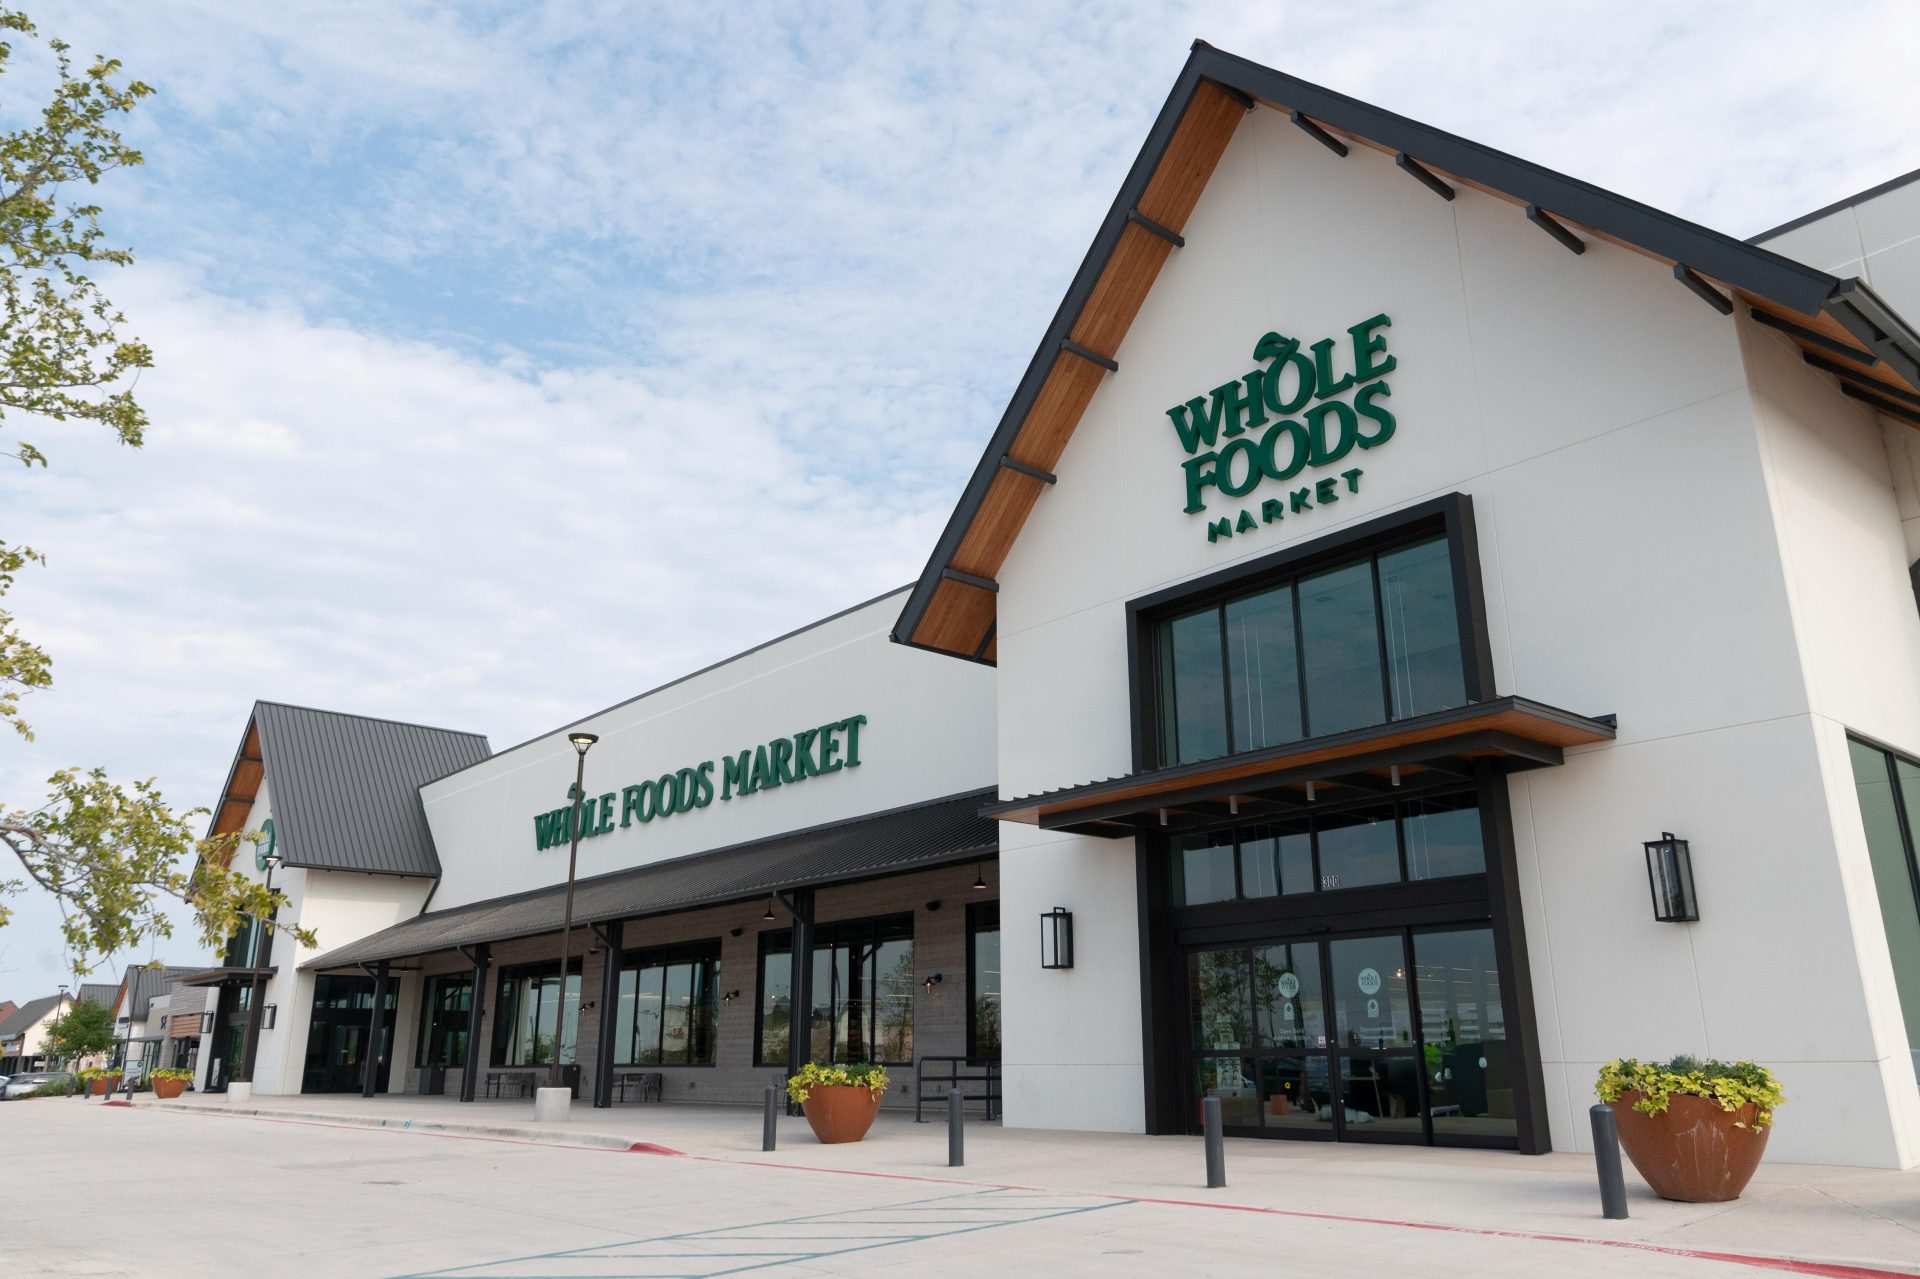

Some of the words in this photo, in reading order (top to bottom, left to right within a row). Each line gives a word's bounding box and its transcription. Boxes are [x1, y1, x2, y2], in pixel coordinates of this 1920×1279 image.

[1165, 313, 1397, 454] WHOLE
[1181, 380, 1397, 515] FOODS
[1207, 468, 1364, 543] MARKET
[534, 783, 616, 851] WHOLE
[620, 760, 715, 828] FOODS
[720, 714, 867, 800] MARKET
[1323, 876, 1339, 887] 300
